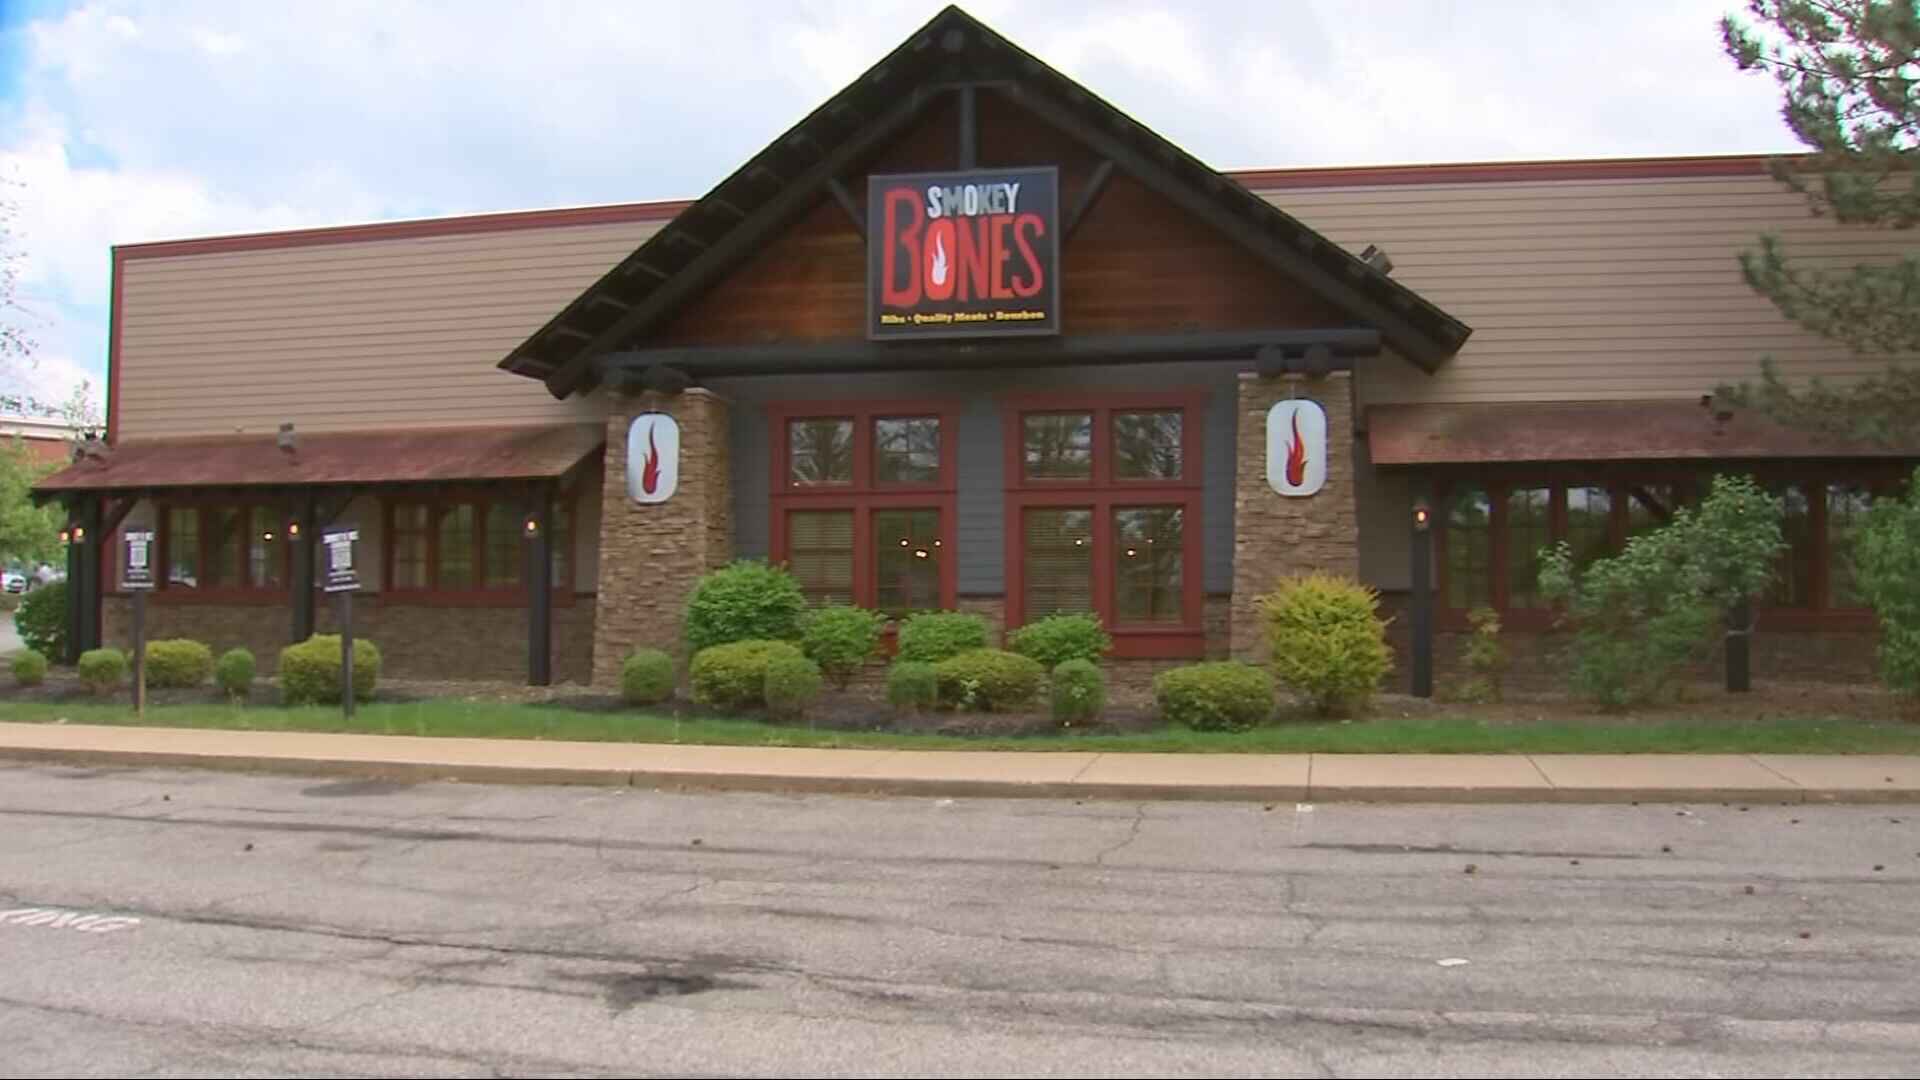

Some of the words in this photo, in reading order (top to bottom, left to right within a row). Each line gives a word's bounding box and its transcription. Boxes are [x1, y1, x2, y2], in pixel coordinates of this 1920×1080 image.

[927, 183, 1020, 219] SMOKEY
[882, 186, 1045, 308] BONES
[914, 313, 953, 325] Quality
[996, 310, 1045, 321] Bourbon
